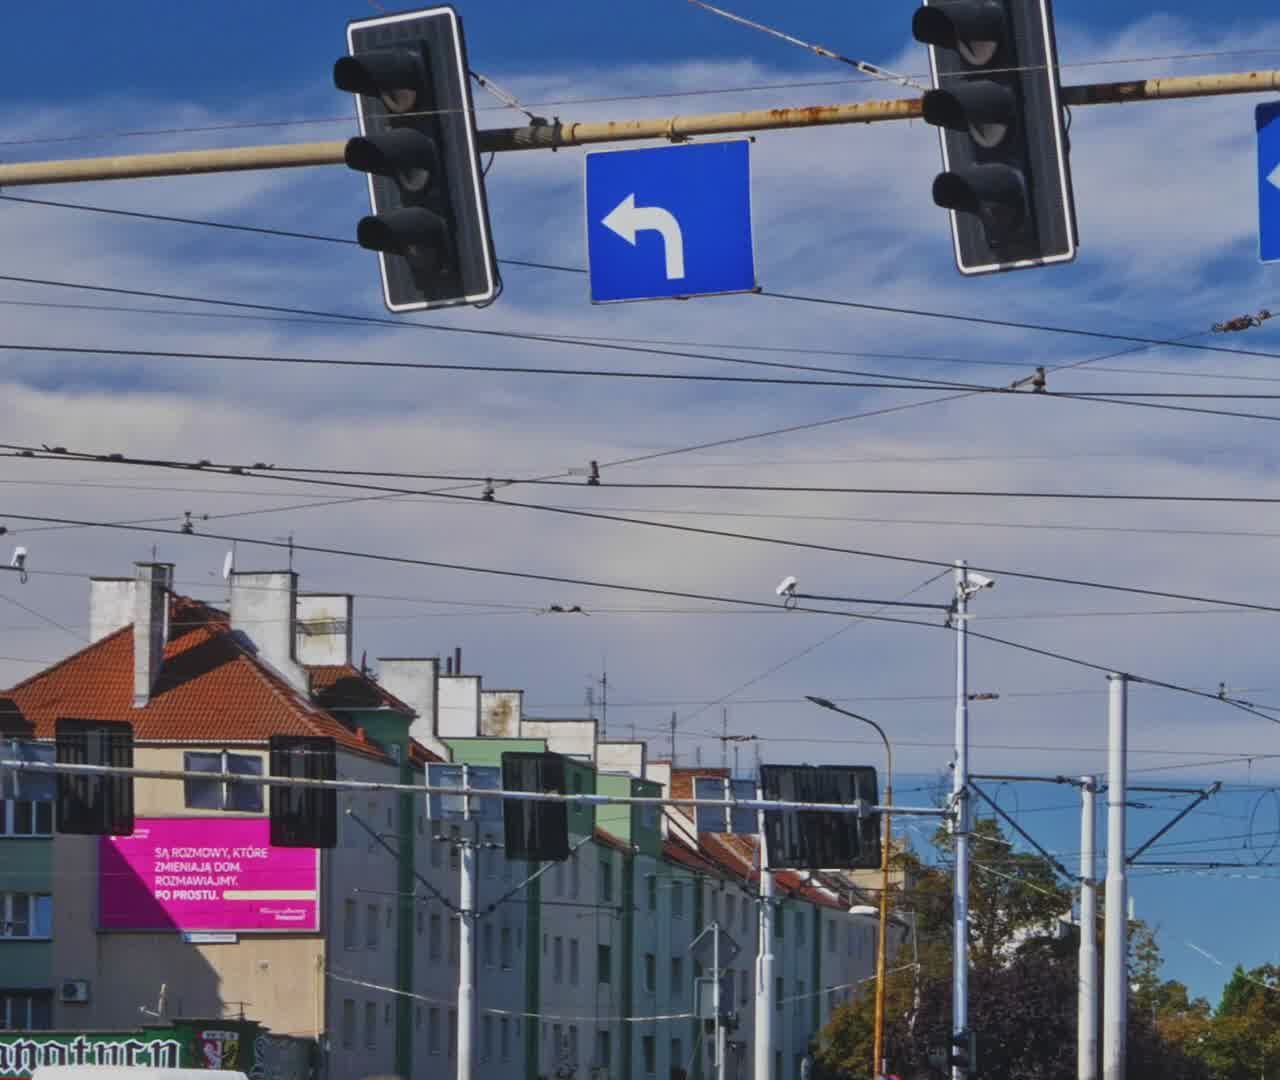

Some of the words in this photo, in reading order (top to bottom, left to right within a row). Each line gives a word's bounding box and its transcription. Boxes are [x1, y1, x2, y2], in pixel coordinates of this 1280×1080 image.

[154, 847, 170, 860] SĄ
[172, 848, 231, 859] ROZMOWY,
[233, 846, 268, 858] KTÓRE
[154, 862, 213, 873] ZMIENIAJĄ
[214, 862, 241, 872] DOM.
[154, 876, 239, 886] ROZMAWIAJMY.
[155, 890, 170, 900] PO
[173, 890, 220, 900] PROSTU.
